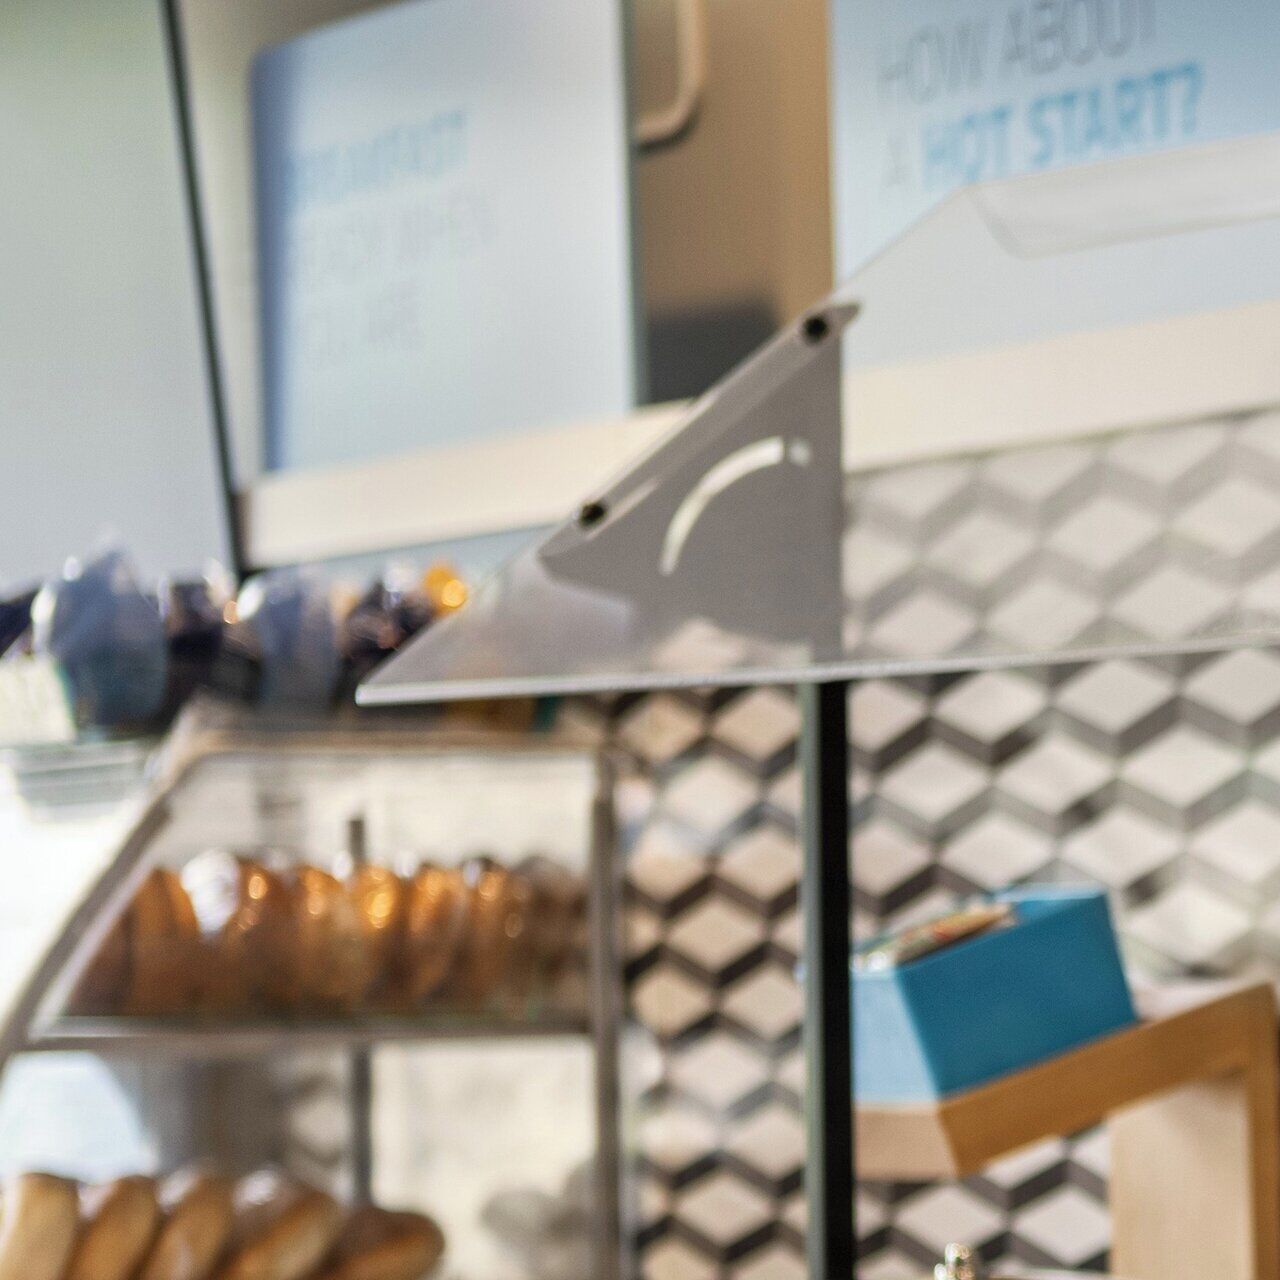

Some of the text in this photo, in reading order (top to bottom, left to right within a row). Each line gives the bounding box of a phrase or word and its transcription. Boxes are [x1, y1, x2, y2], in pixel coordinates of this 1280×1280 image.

[877, 18, 988, 104] HOW
[921, 106, 1013, 190] HOT
[1027, 61, 1204, 168] START?
